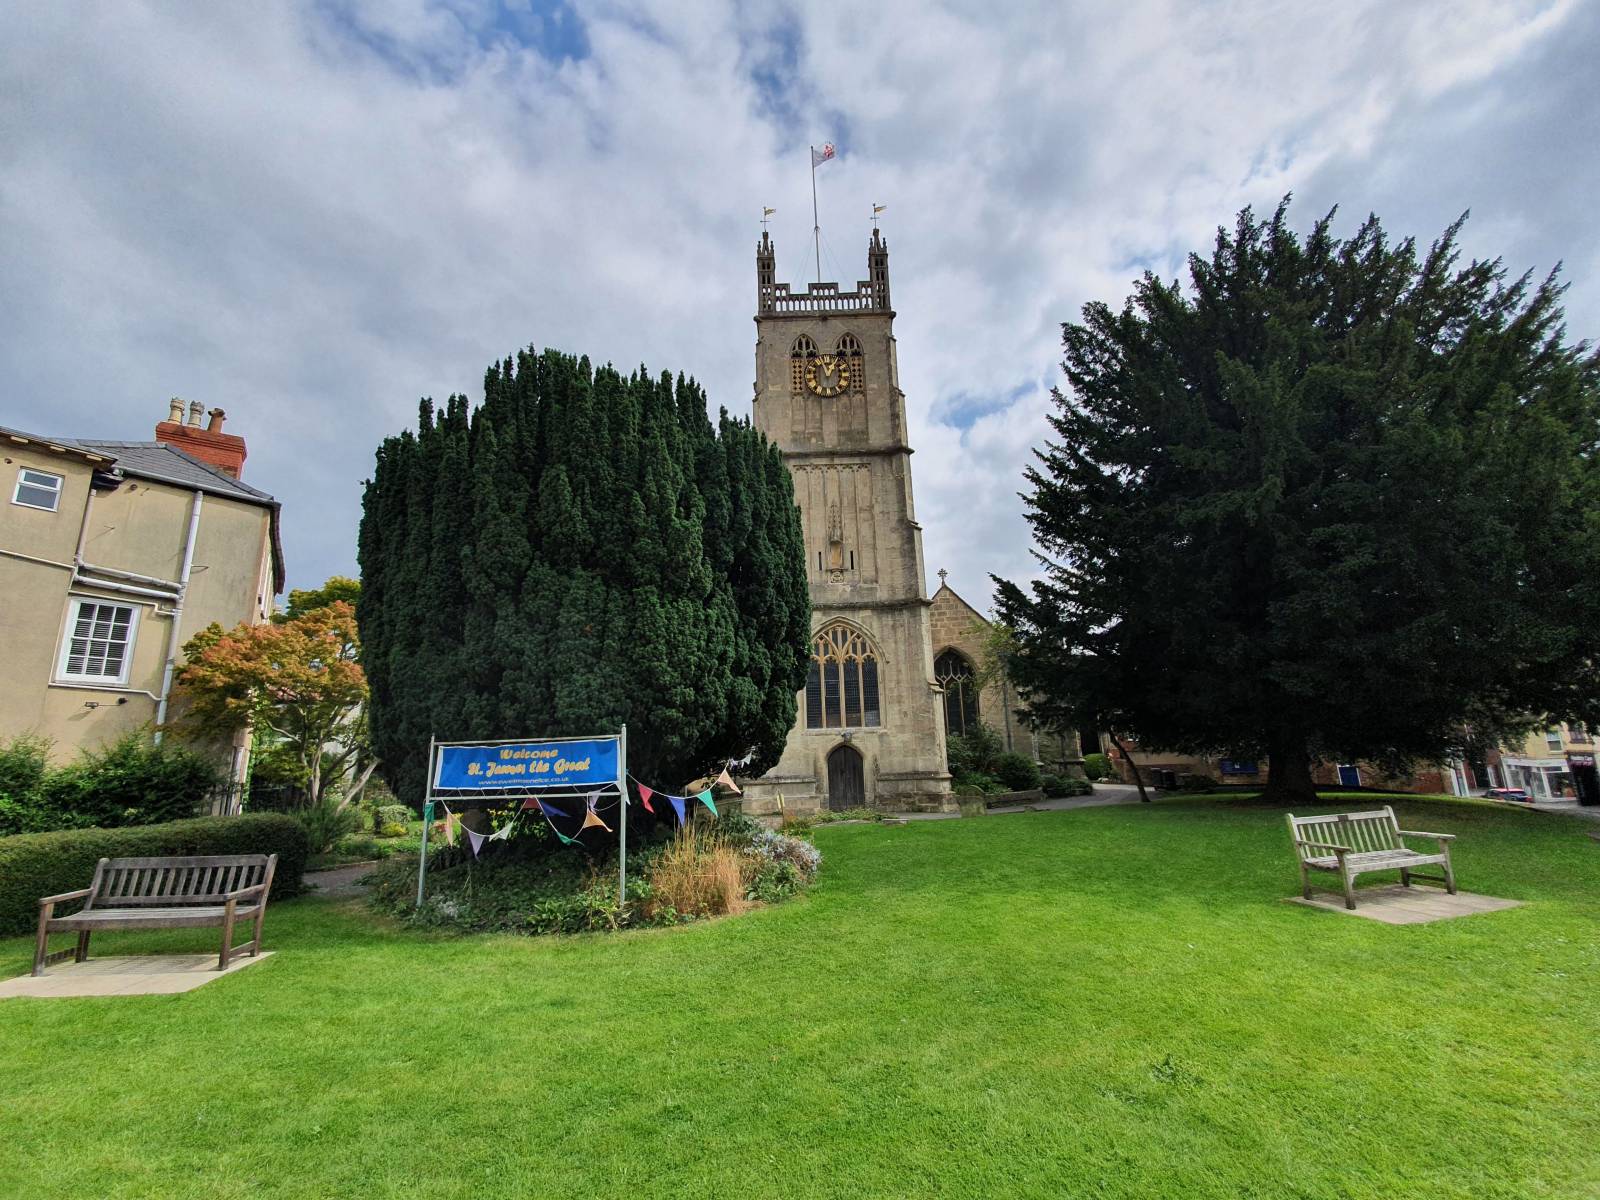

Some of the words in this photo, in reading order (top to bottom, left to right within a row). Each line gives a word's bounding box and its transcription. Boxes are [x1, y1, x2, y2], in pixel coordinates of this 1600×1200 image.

[500, 749, 558, 759] Welcome
[486, 762, 526, 777] James
[529, 760, 550, 773] the
[554, 757, 590, 774] Great
